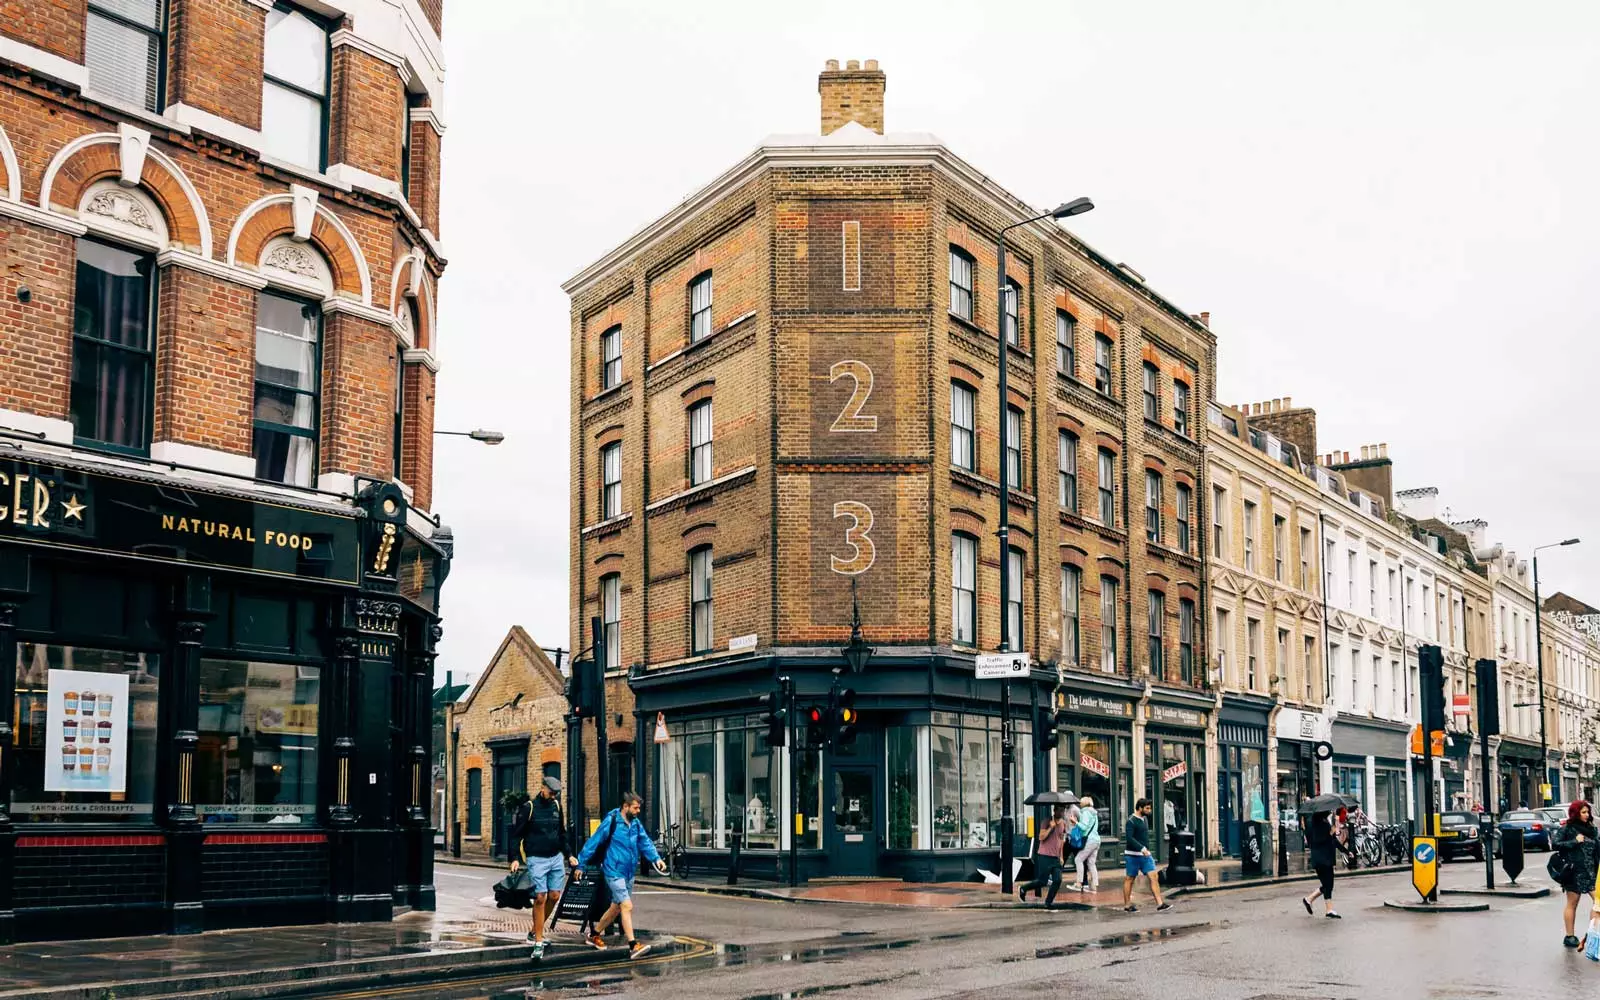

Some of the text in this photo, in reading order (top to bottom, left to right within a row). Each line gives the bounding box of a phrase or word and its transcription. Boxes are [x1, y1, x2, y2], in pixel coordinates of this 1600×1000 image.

[829, 360, 877, 432] 2
[162, 514, 313, 550] NATURAL FOOD
[830, 500, 876, 574] 3
[1068, 693, 1123, 710] The Leather Warehouse
[1153, 704, 1162, 716] The
[1162, 706, 1178, 718] Leather
[1178, 708, 1198, 721] Warehouse
